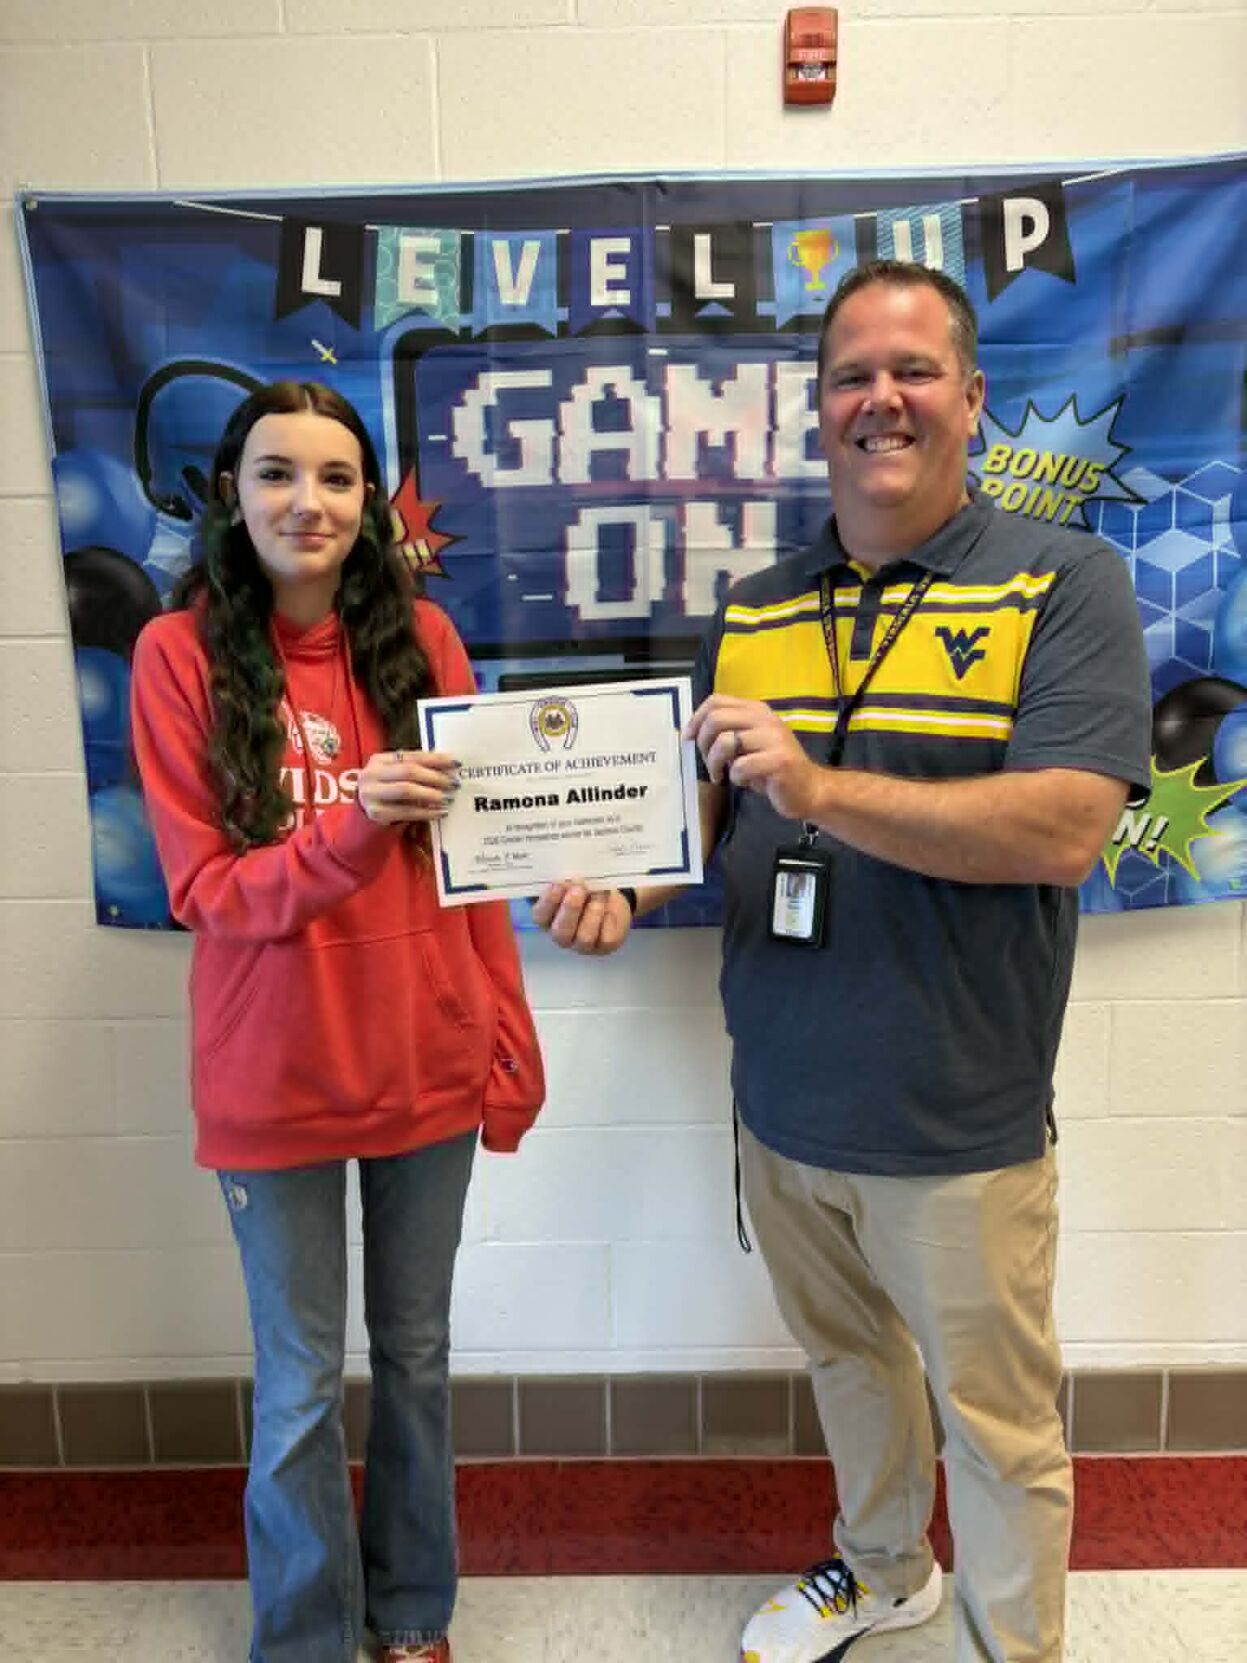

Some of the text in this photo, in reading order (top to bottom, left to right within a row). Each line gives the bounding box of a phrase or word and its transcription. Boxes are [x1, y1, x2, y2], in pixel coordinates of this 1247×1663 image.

[301, 197, 1049, 306] LEVEL UP
[453, 361, 829, 487] GAME
[982, 443, 1105, 494] BONUS
[980, 477, 1085, 525] POINT
[565, 501, 777, 620] ON
[459, 761, 541, 779] CERTIFICATE
[544, 759, 561, 773] OF
[565, 751, 656, 770] ACHIEVEMENT
[474, 784, 648, 812] Ramona Allinder
